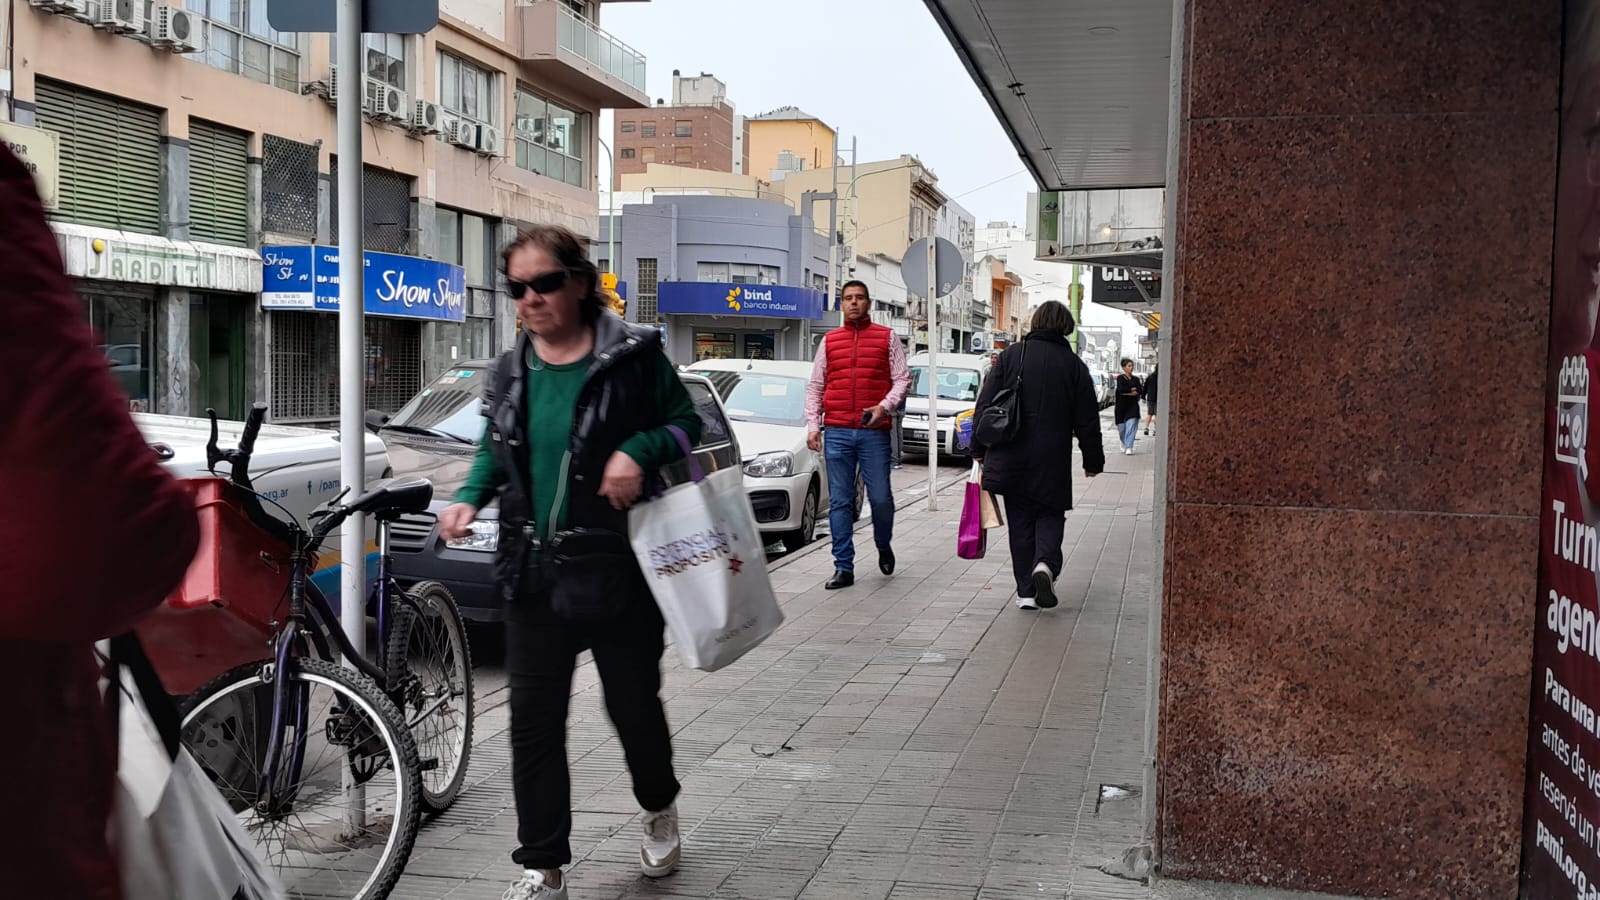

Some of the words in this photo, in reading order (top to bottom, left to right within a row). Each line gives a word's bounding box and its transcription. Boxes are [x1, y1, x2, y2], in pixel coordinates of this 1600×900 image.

[9, 142, 28, 155] POR
[23, 161, 38, 174] OR
[376, 270, 431, 307] Show
[743, 289, 772, 301] bind
[743, 301, 768, 310] banco
[768, 302, 797, 311] industrial
[1544, 667, 1570, 713] Para
[1571, 695, 1595, 734] una
[1542, 722, 1570, 766] antes
[1571, 743, 1586, 782] de
[1539, 770, 1577, 829] reservá
[1578, 813, 1594, 849] un
[1536, 818, 1600, 900] pami.org.a
